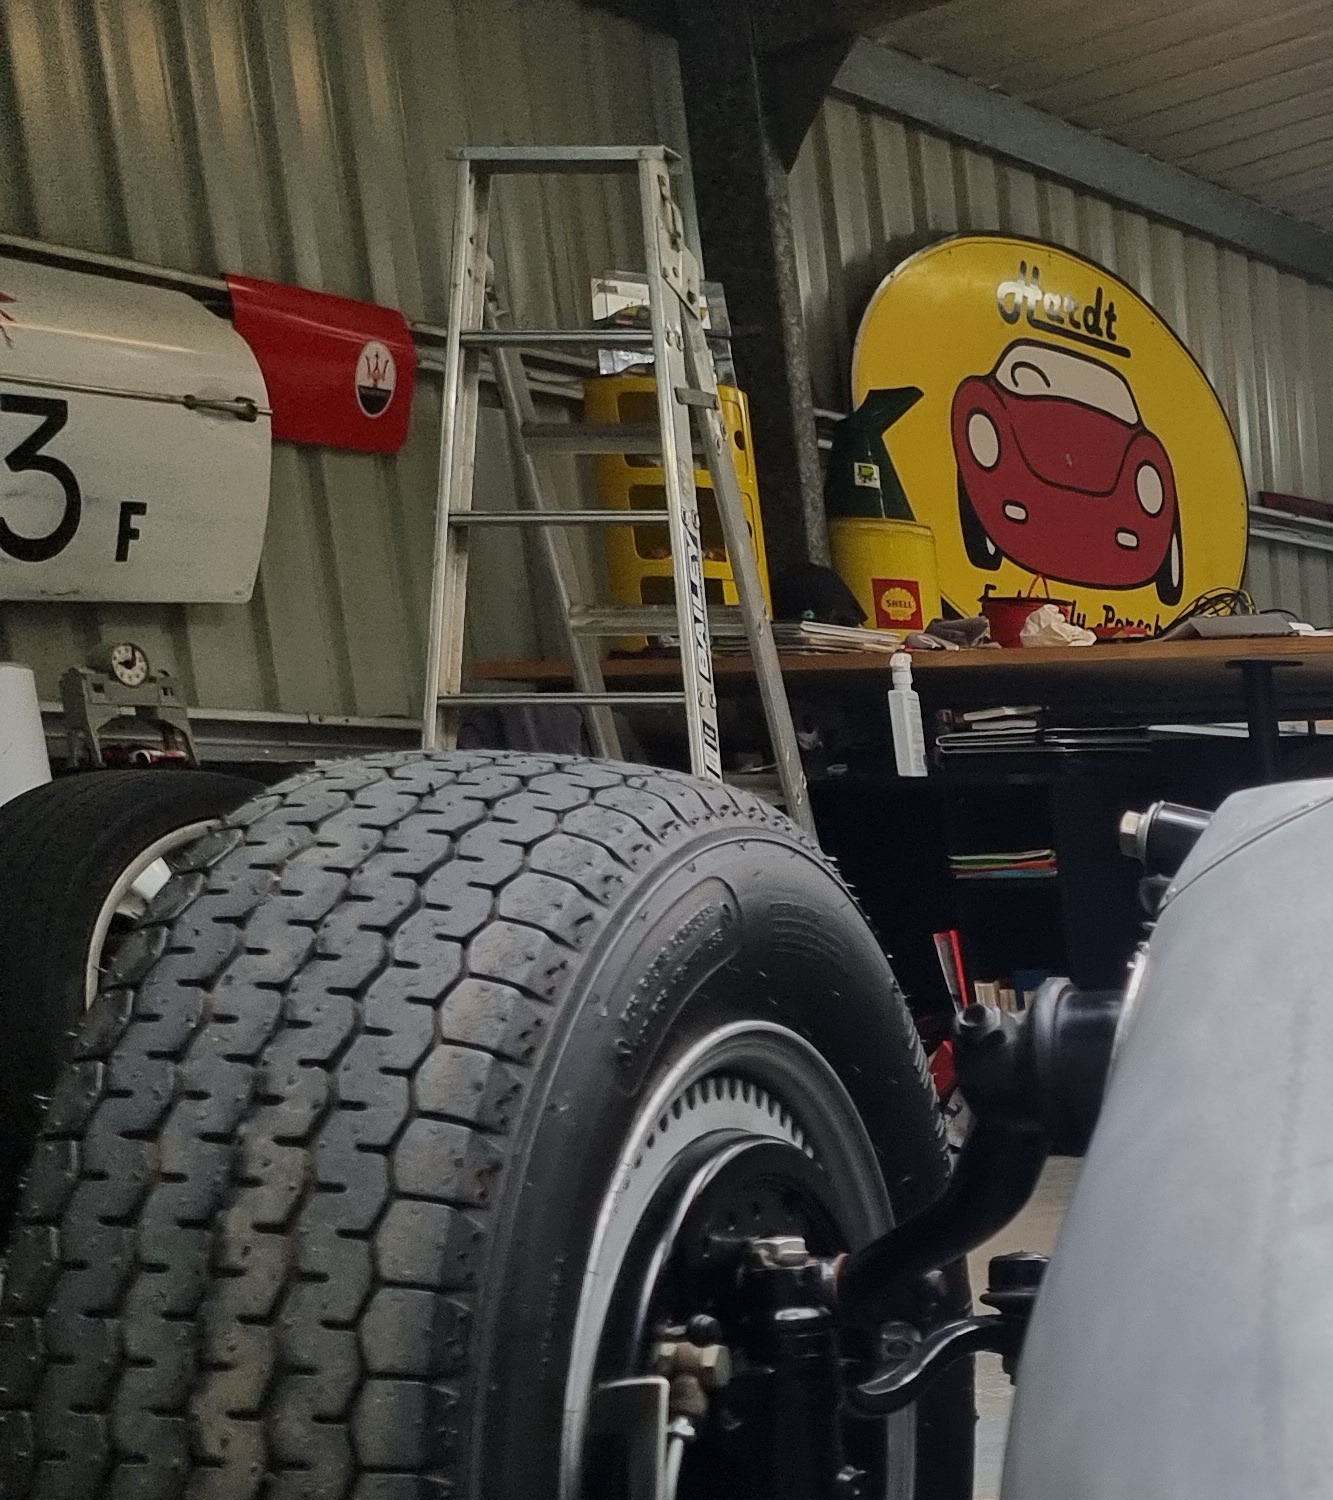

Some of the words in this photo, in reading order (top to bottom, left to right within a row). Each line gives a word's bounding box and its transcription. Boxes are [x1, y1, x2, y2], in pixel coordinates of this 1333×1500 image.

[997, 260, 1125, 350] Hardt
[115, 501, 147, 562] F
[687, 527, 711, 681] BAILEY
[886, 599, 913, 609] SHELL
[1090, 604, 1166, 638] Porsch
